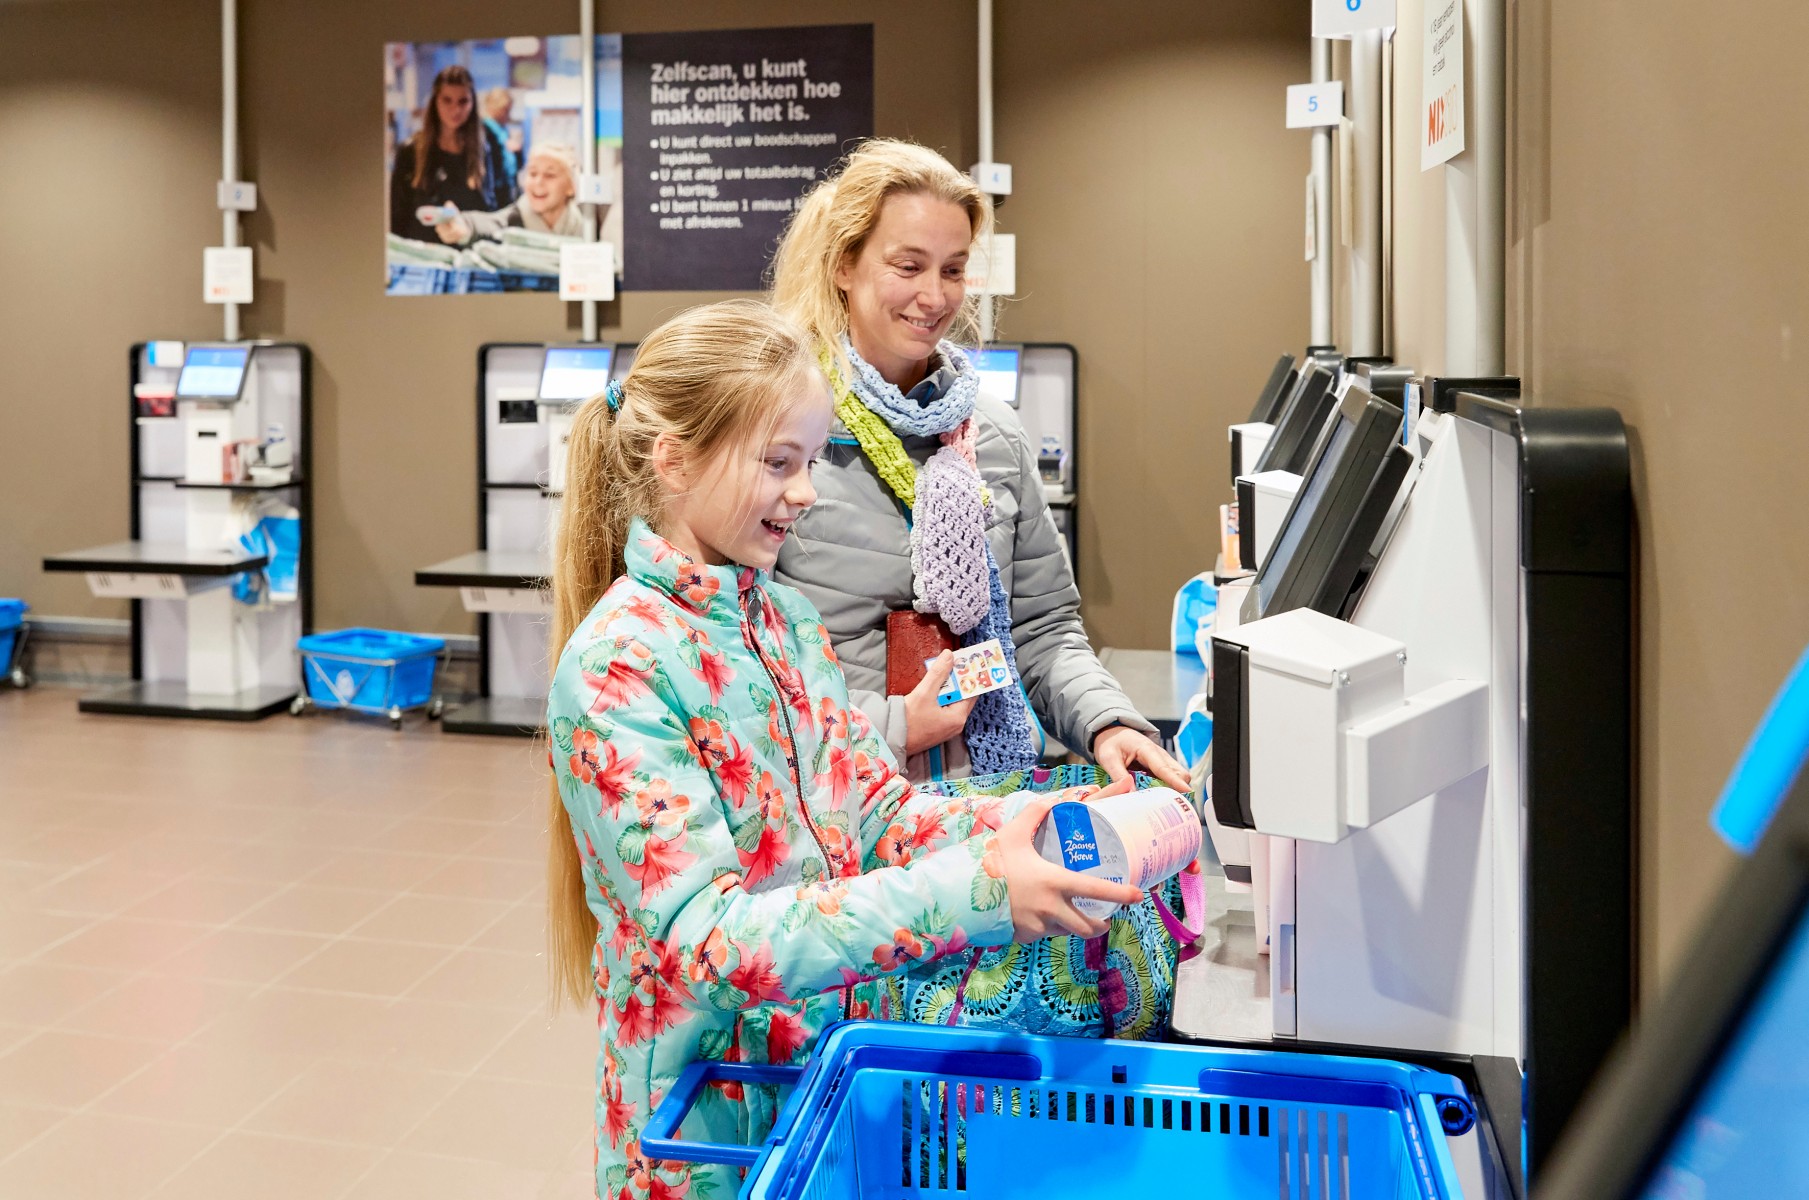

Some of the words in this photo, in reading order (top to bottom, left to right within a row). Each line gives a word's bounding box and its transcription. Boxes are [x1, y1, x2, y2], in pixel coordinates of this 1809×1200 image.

[650, 61, 738, 83] Zelfscan,
[743, 64, 756, 79] u
[762, 59, 806, 78] kunt
[651, 84, 690, 104] hier
[694, 80, 797, 102] ontdekken
[804, 79, 841, 98] hoe
[1308, 95, 1318, 112] 5
[651, 103, 744, 127] makkelijk
[750, 102, 782, 122] het
[788, 101, 810, 121] is.
[660, 136, 670, 149] U
[672, 136, 697, 148] kunt
[699, 135, 732, 148] direct
[735, 136, 752, 147] uw
[754, 133, 836, 146] boodschappen
[660, 151, 713, 168] inpakken.
[660, 168, 670, 181] U
[672, 168, 692, 181] ziet
[694, 167, 723, 182] altijd
[725, 169, 743, 180] uw
[744, 165, 815, 180] totaalbedrag
[660, 186, 675, 197] en
[677, 183, 719, 198] korting.
[660, 200, 670, 213] U
[672, 200, 698, 213] bent
[700, 199, 739, 212] binnen
[742, 199, 748, 212] 1
[752, 199, 792, 211] minuut
[660, 217, 683, 229] met
[685, 215, 743, 229] afrekenen.
[1072, 830, 1085, 841] De
[1064, 841, 1096, 853] Zaanse
[1068, 851, 1094, 864] Hoeve
